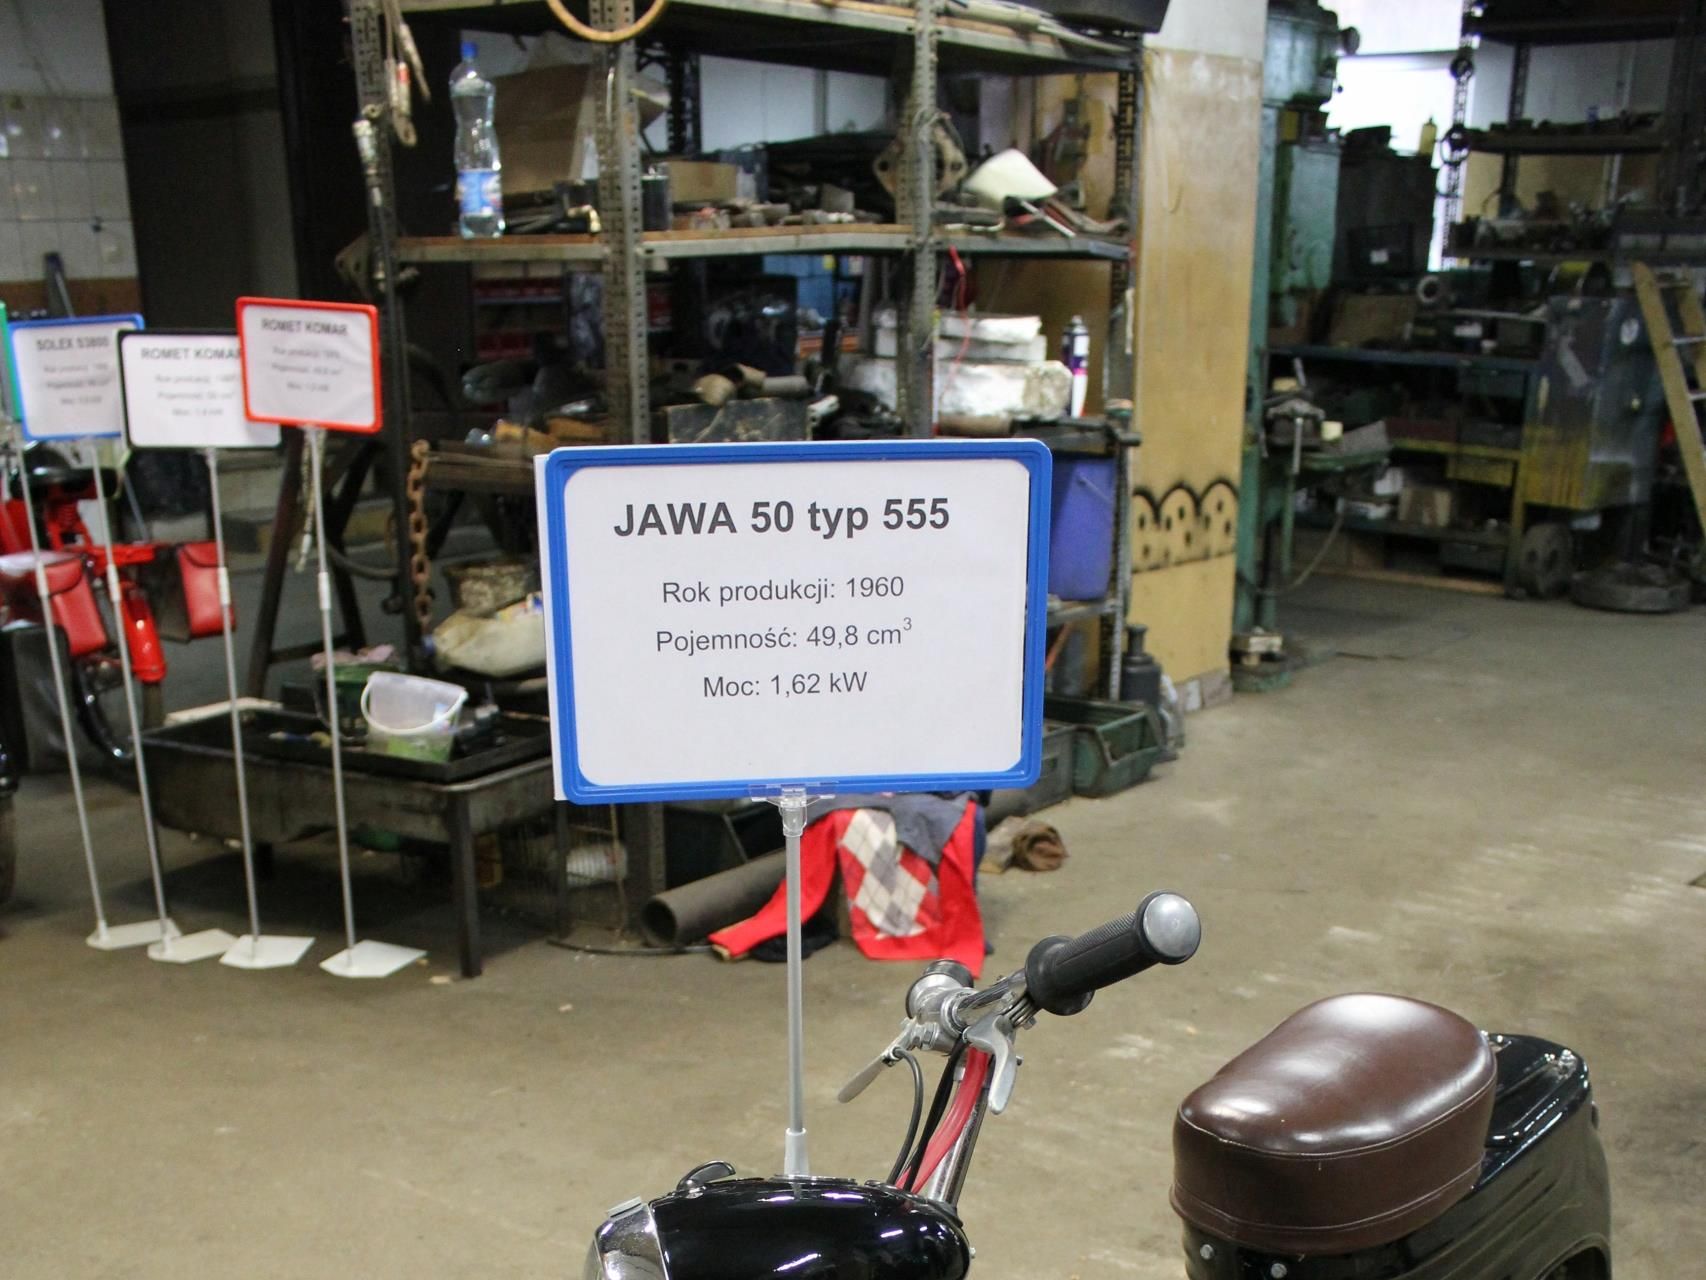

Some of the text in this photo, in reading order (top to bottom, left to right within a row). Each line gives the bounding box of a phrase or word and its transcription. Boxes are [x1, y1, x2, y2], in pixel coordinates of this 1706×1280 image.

[141, 347, 190, 360] ROMET
[613, 497, 950, 539] JAWA 50 typ 555
[662, 576, 904, 607] Rok produkcji: 1960
[656, 627, 798, 657] Pojemność:
[806, 625, 859, 651] 49,8
[703, 671, 868, 698] Moc: 1,62 kW
